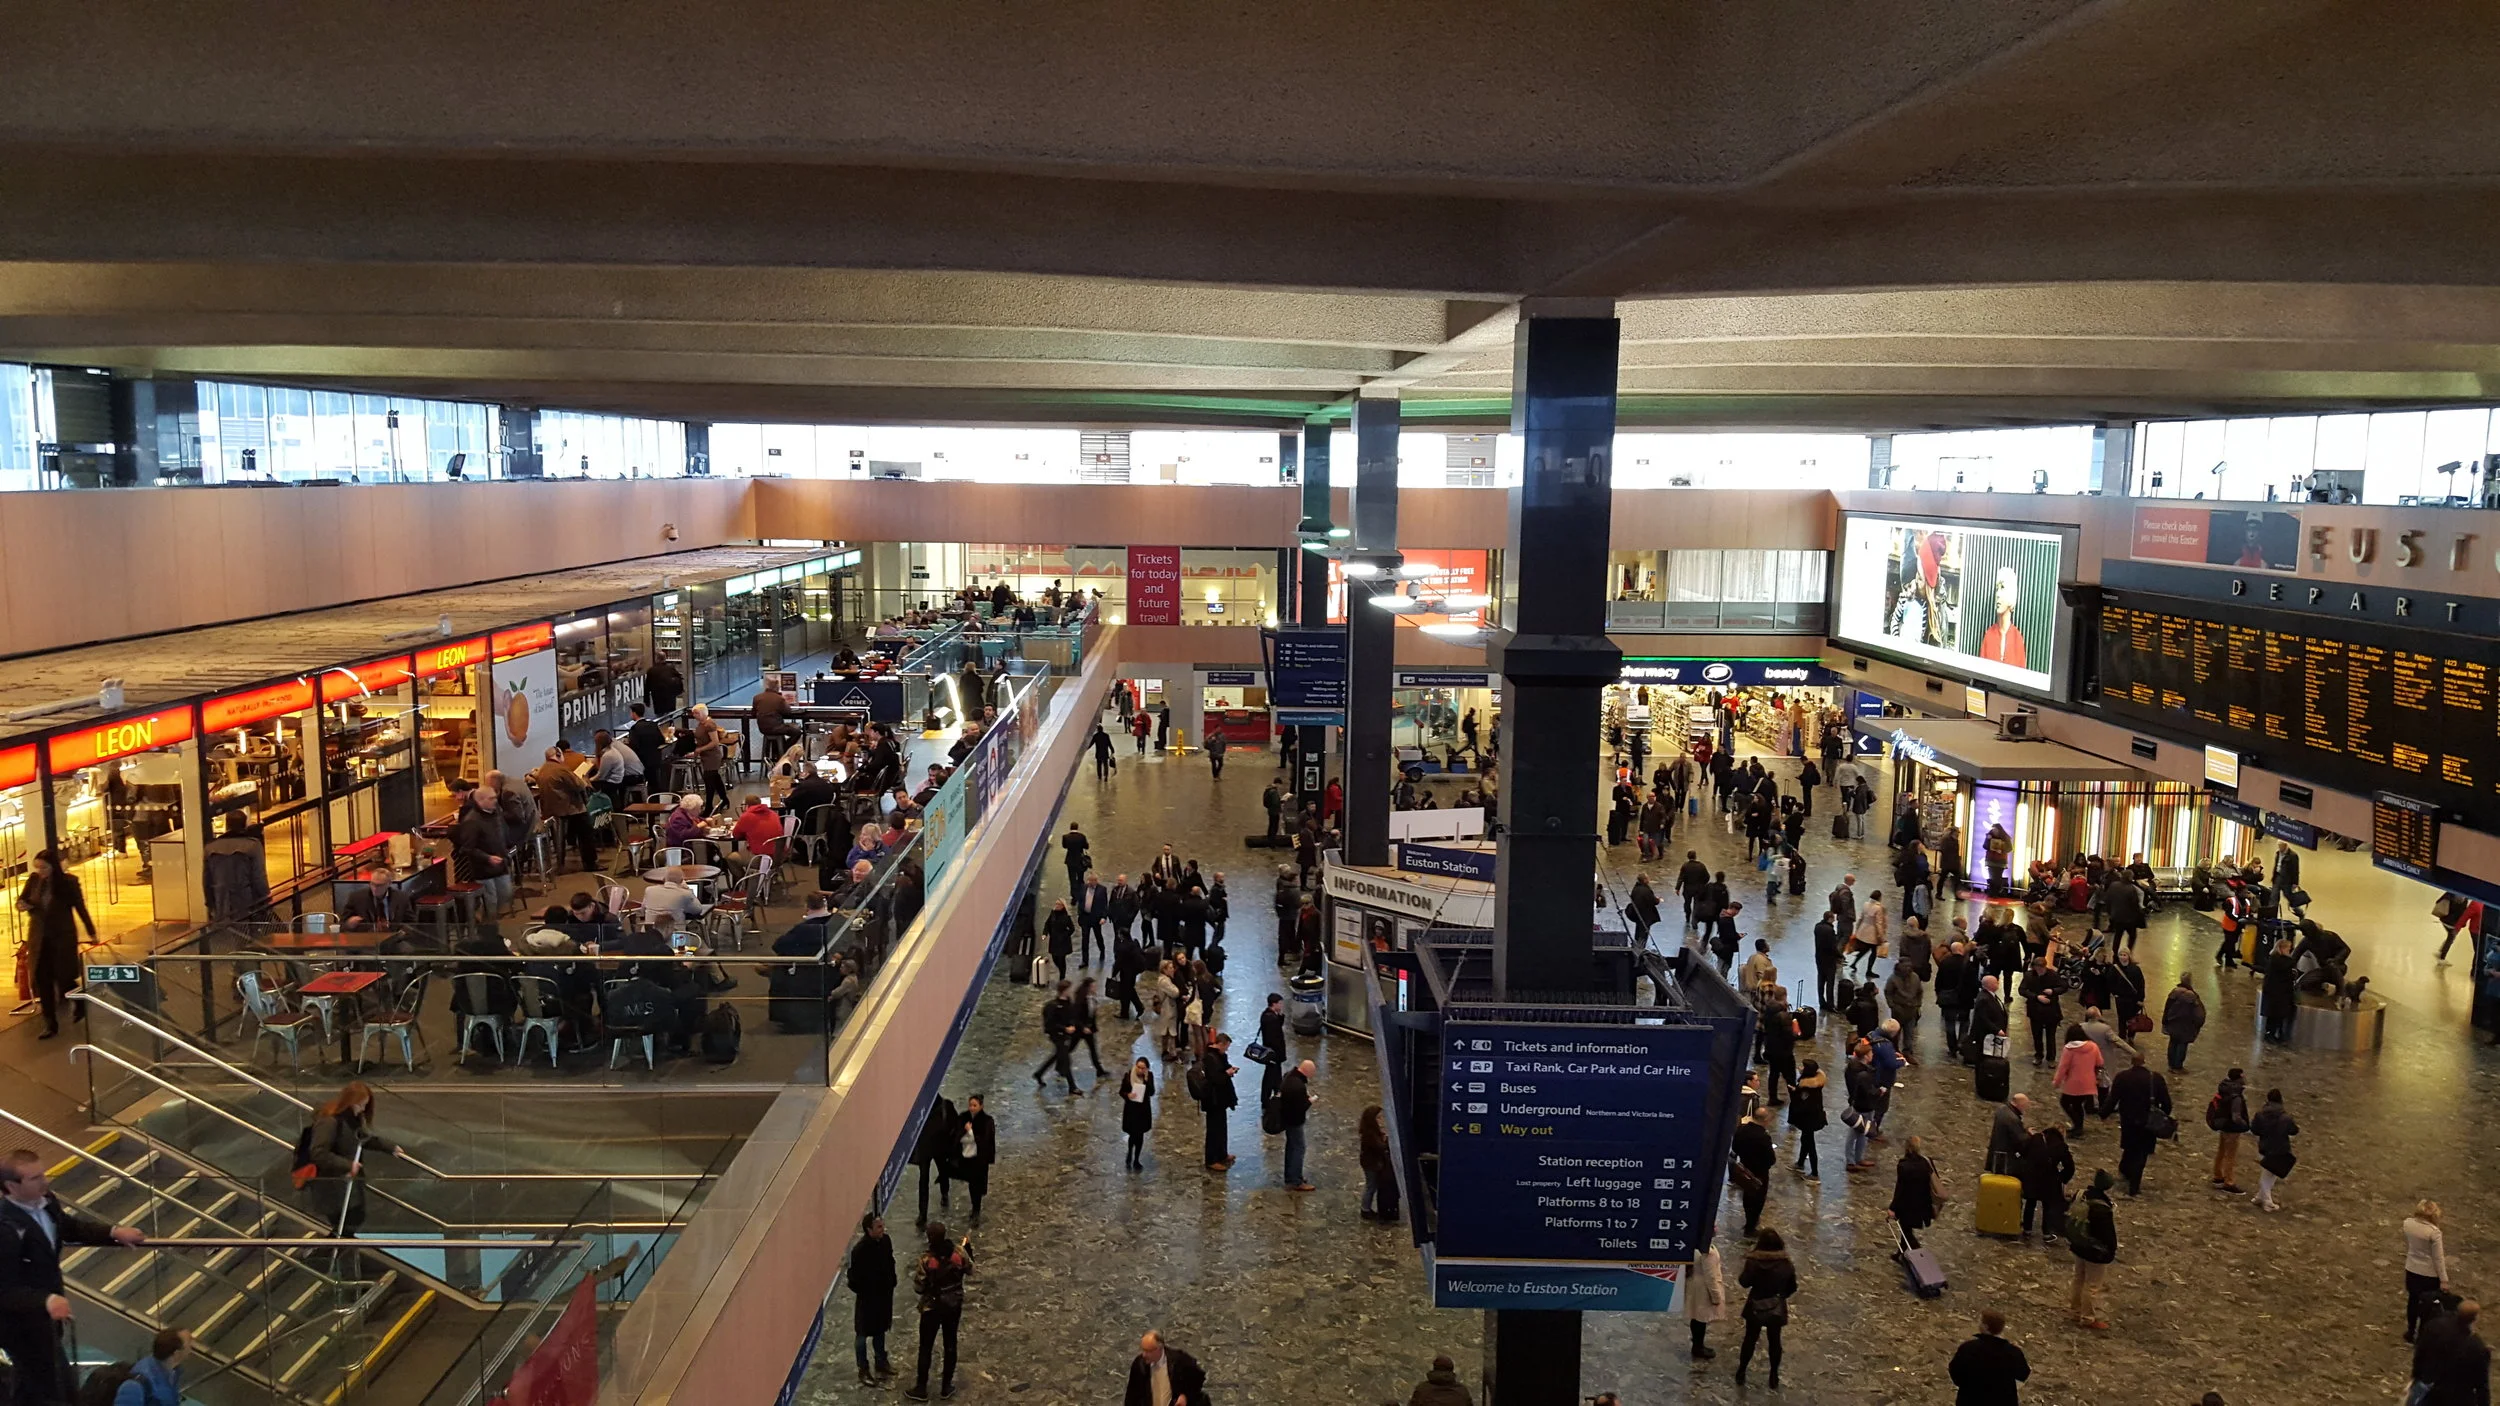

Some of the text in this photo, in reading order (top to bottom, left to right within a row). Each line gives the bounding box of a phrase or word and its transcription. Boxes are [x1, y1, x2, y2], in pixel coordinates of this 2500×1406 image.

[2143, 520, 2197, 532] Please check before
[2140, 534, 2199, 545] you travel this Easter
[2310, 526, 2500, 573] EUST
[1137, 553, 1172, 565] Tickets
[1131, 568, 1177, 582] for today
[1145, 583, 1163, 594] and
[1138, 598, 1170, 609] future
[2232, 579, 2500, 627] DEPART
[1140, 612, 1168, 623] travel
[437, 646, 466, 670] LEON
[1765, 666, 1809, 681] beauty
[614, 674, 647, 707] PRIM
[563, 689, 606, 727] PRIME
[96, 719, 152, 758] LEON
[2382, 795, 2420, 811] ARRIVALS ONLY
[1406, 856, 1479, 874] Euston Station
[2407, 864, 2420, 875] ONLY
[1334, 876, 1432, 911] INFORMATION
[2262, 934, 2268, 945] 3
[1504, 1041, 1648, 1055] Tickets and information
[1506, 1061, 1691, 1077] Taxi Rank, Car Park and Car Hire
[1500, 1082, 1537, 1095] Buses
[1500, 1103, 1580, 1117] Underground
[1586, 1109, 1616, 1117] Northern
[1500, 1124, 1553, 1137] Way out
[1538, 1156, 1643, 1170] Station reception
[1516, 1179, 1530, 1187] Lost
[1566, 1177, 1591, 1190] Left
[1594, 1178, 1642, 1192] luggage
[1538, 1196, 1640, 1209] Platforms 8 to 18
[1545, 1217, 1639, 1230] Platforms 1 to 7
[1598, 1237, 1638, 1250] Toilets
[1448, 1280, 1618, 1296] Welcome to Euston Station
